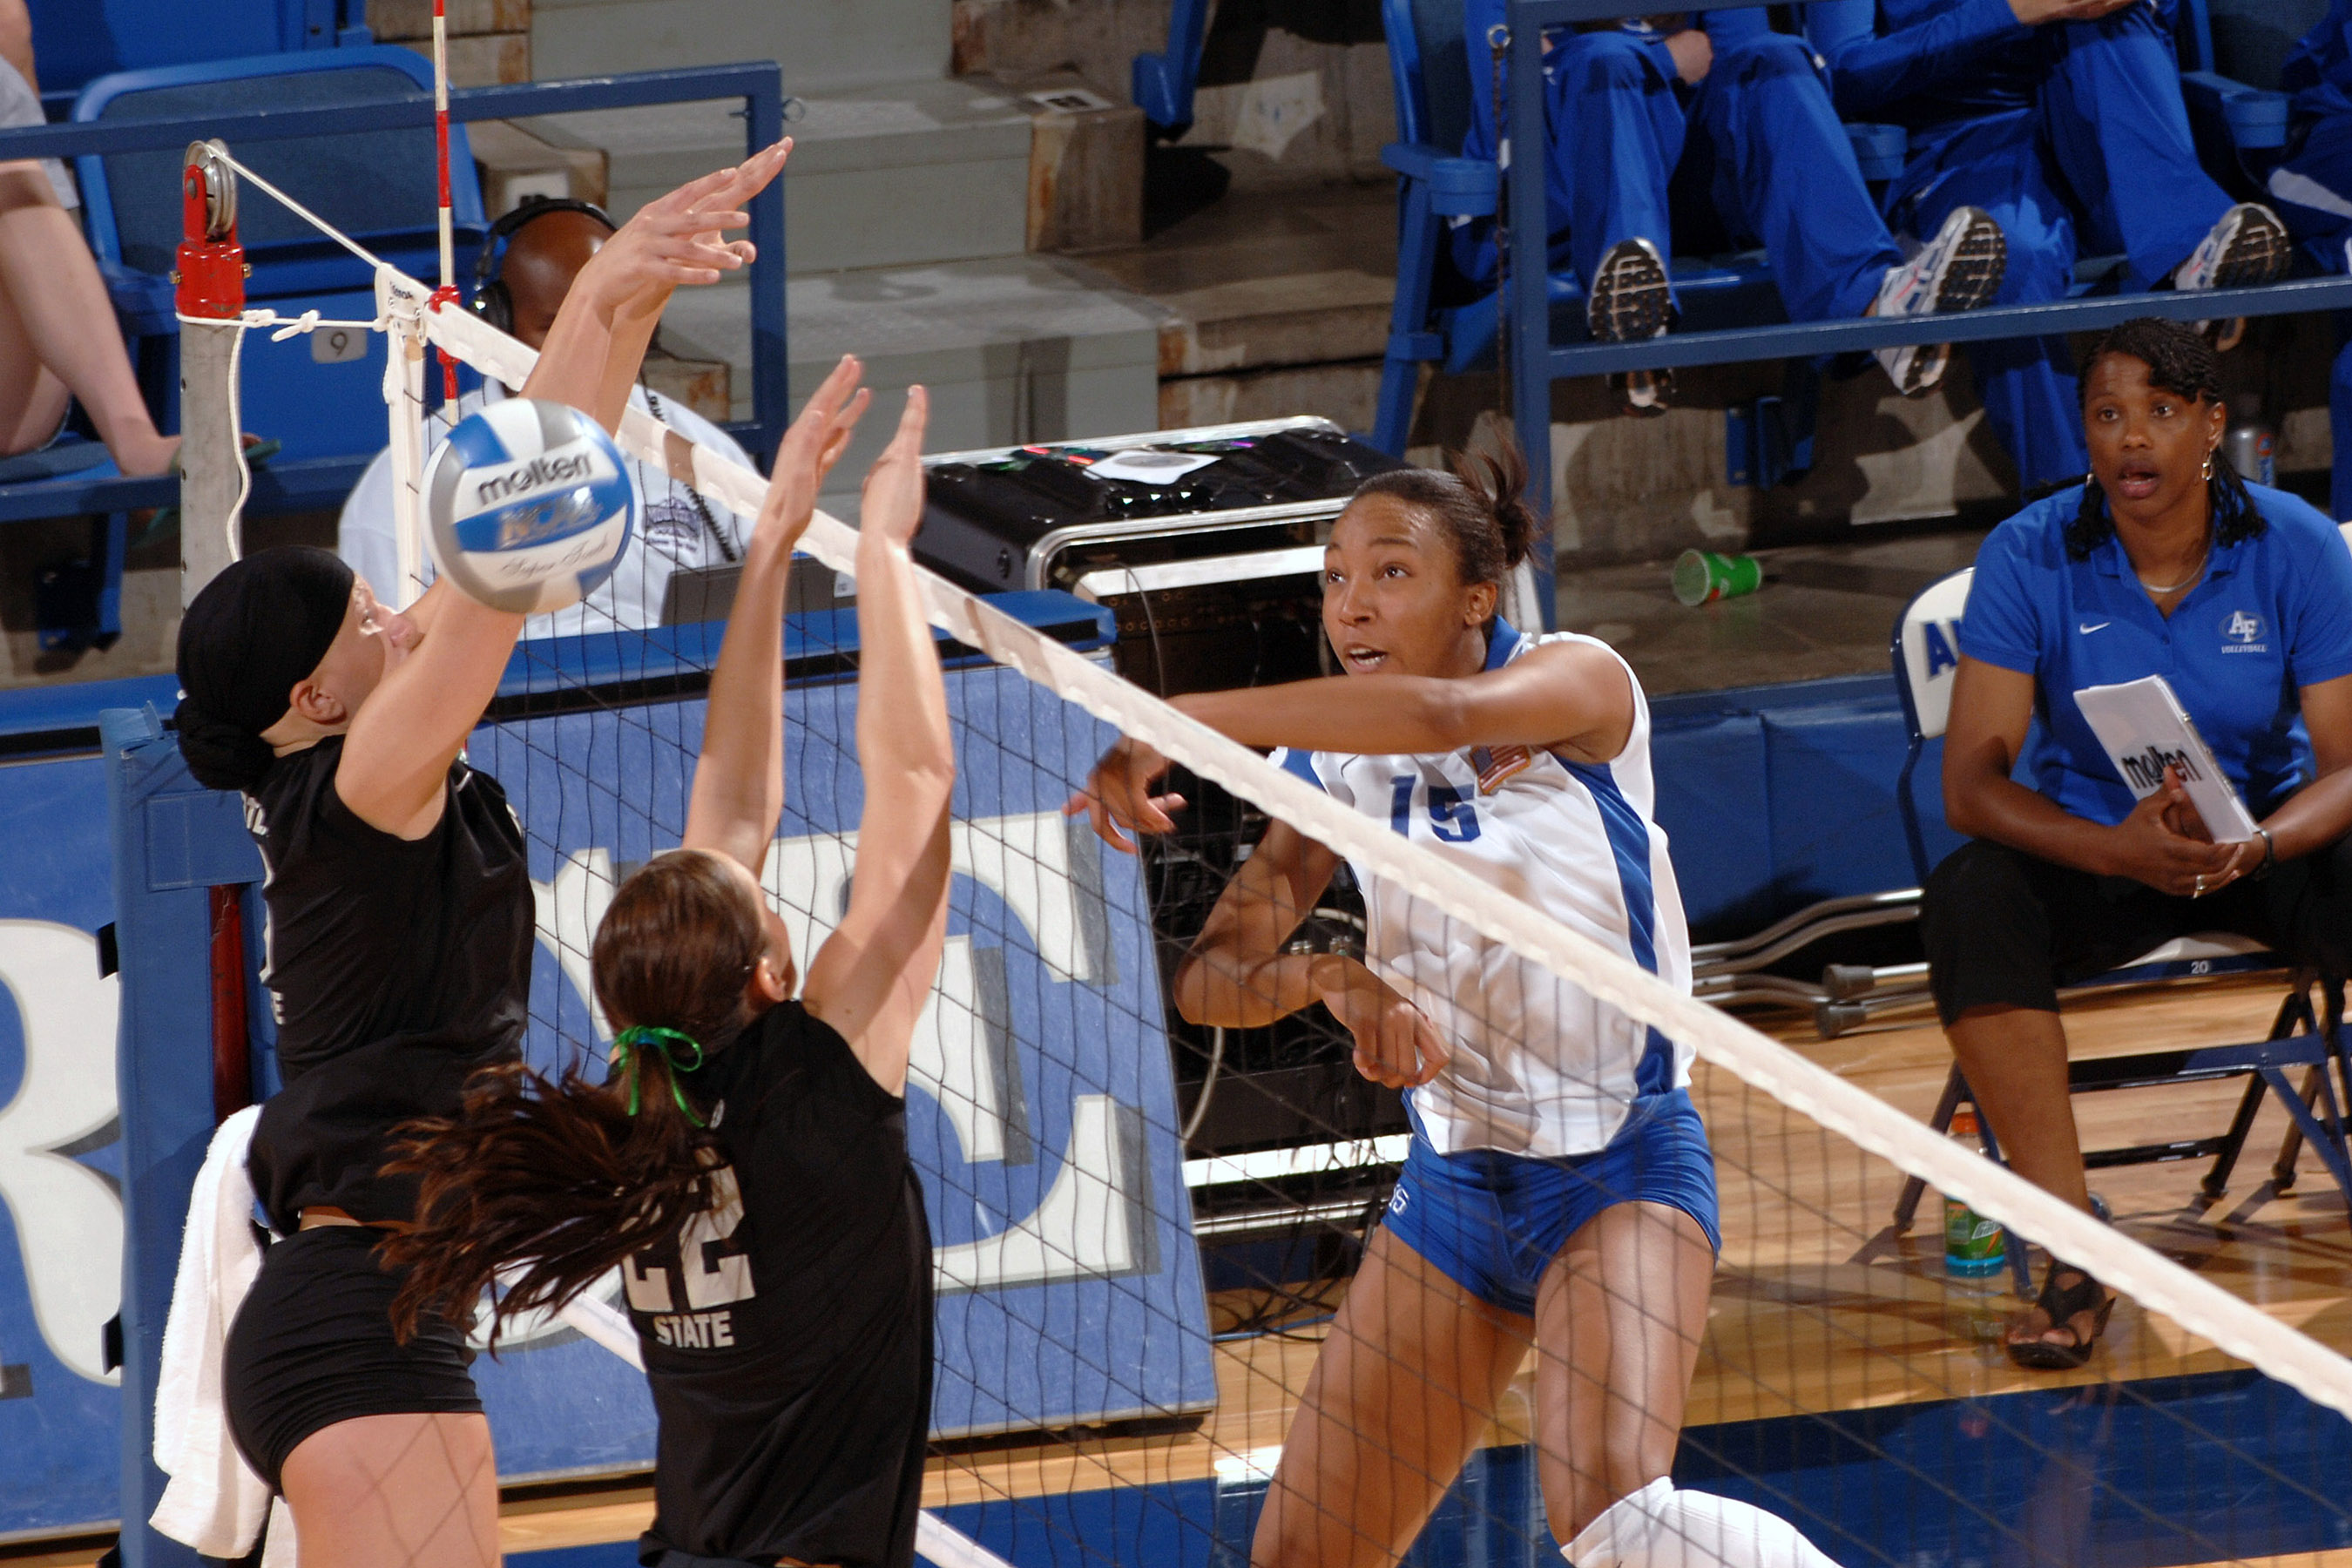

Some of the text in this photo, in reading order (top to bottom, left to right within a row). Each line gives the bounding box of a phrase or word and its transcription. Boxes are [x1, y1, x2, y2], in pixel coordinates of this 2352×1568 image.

[329, 331, 348, 356] 9
[477, 453, 592, 506] molten
[1389, 773, 1481, 842] 15
[2191, 960, 2209, 975] 20
[654, 1308, 735, 1349] STATE
